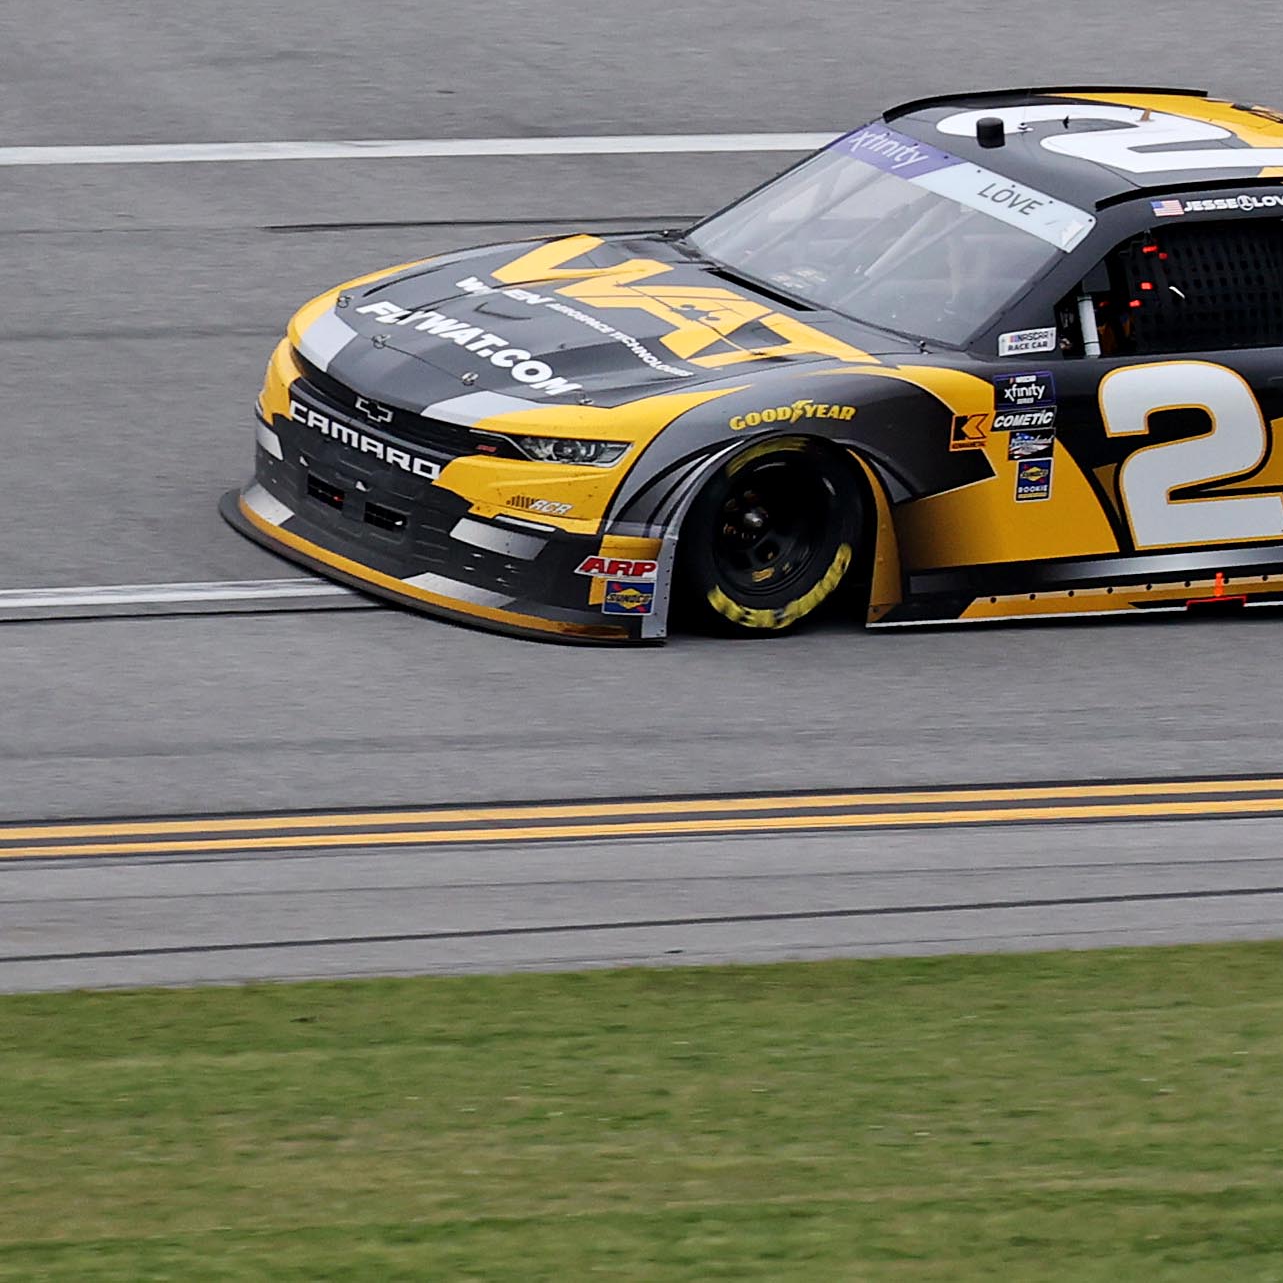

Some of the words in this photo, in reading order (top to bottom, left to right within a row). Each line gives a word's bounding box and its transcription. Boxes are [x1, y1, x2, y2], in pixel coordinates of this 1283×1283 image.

[849, 130, 929, 170] xfinity
[977, 183, 1043, 216] LOVE
[1184, 197, 1237, 212] JESSE
[490, 233, 882, 368] WAT
[356, 300, 583, 397] FLYWAT.COM
[1007, 342, 1029, 352] RACE
[1031, 341, 1048, 350] CAR
[1004, 383, 1045, 402] xfinity
[728, 399, 856, 431] GOODYEAR
[993, 408, 1053, 428] COMETIC
[289, 399, 440, 480] CAMARO
[1017, 484, 1048, 494] ROOKIE
[579, 557, 657, 576] ARP
